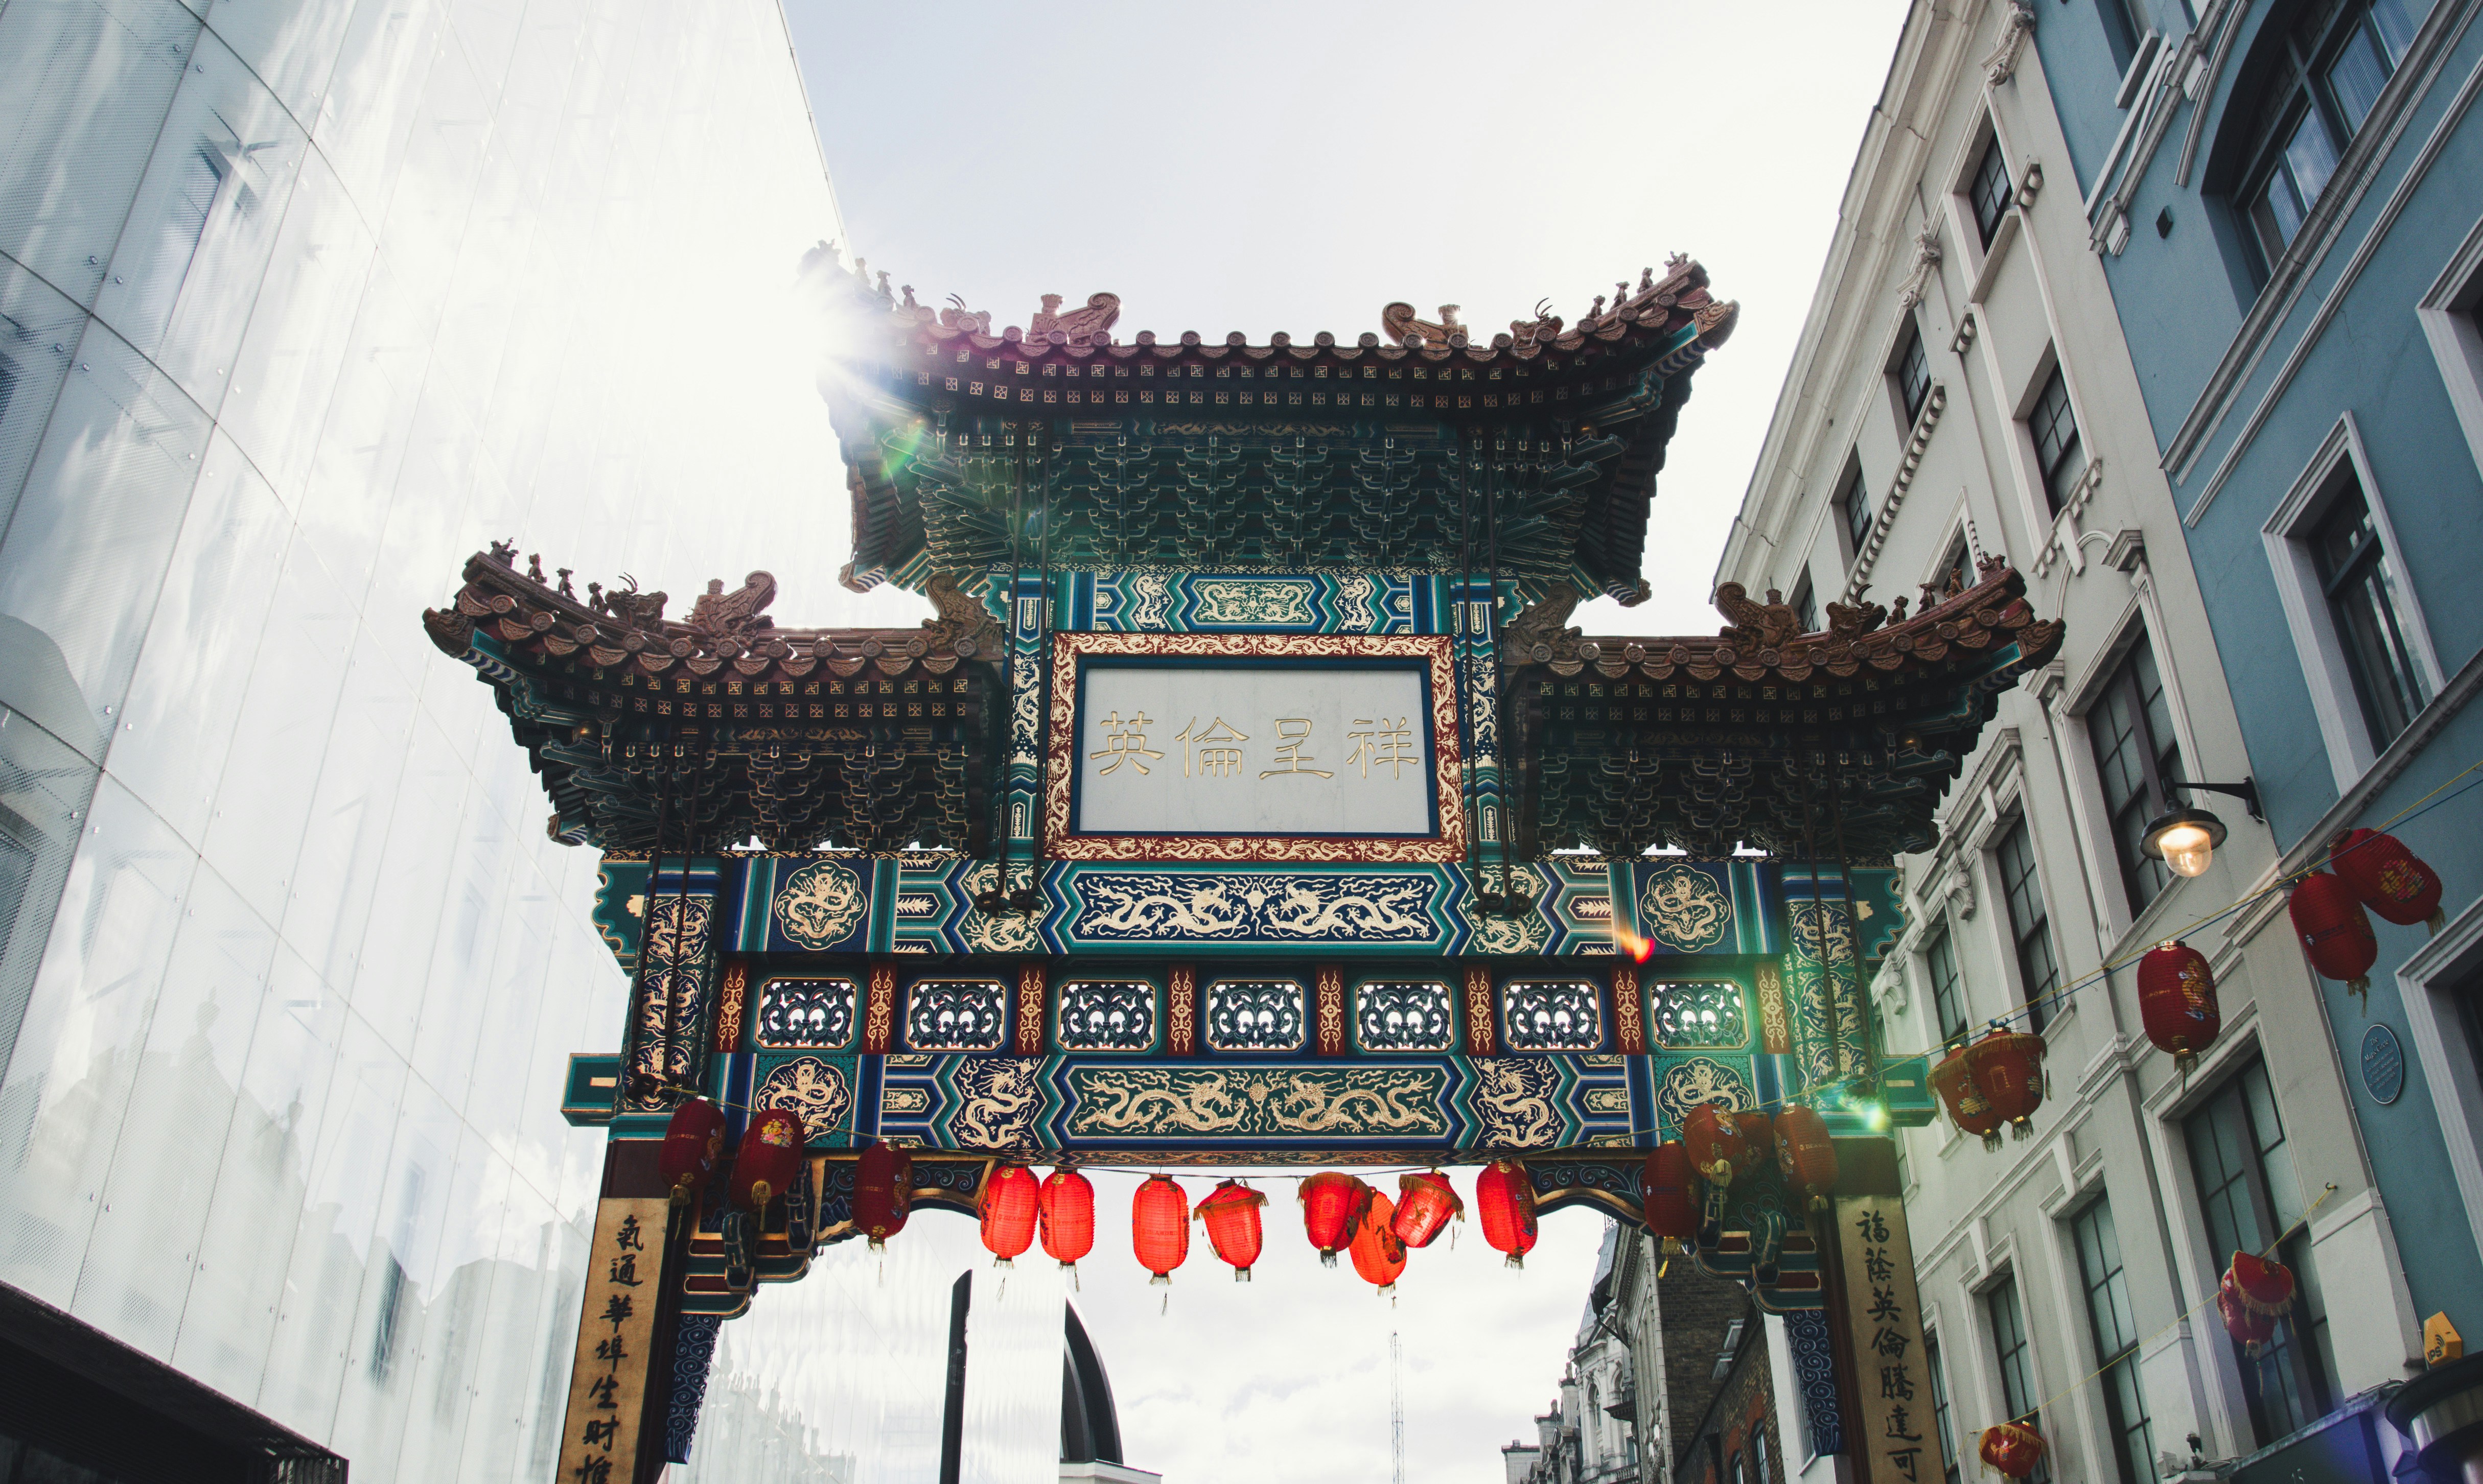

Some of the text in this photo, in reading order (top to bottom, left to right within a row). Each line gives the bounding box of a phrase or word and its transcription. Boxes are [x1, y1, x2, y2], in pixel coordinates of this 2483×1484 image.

[1089, 711, 1420, 780] 英倫呈祥
[2427, 1346, 2442, 1362] IPS
